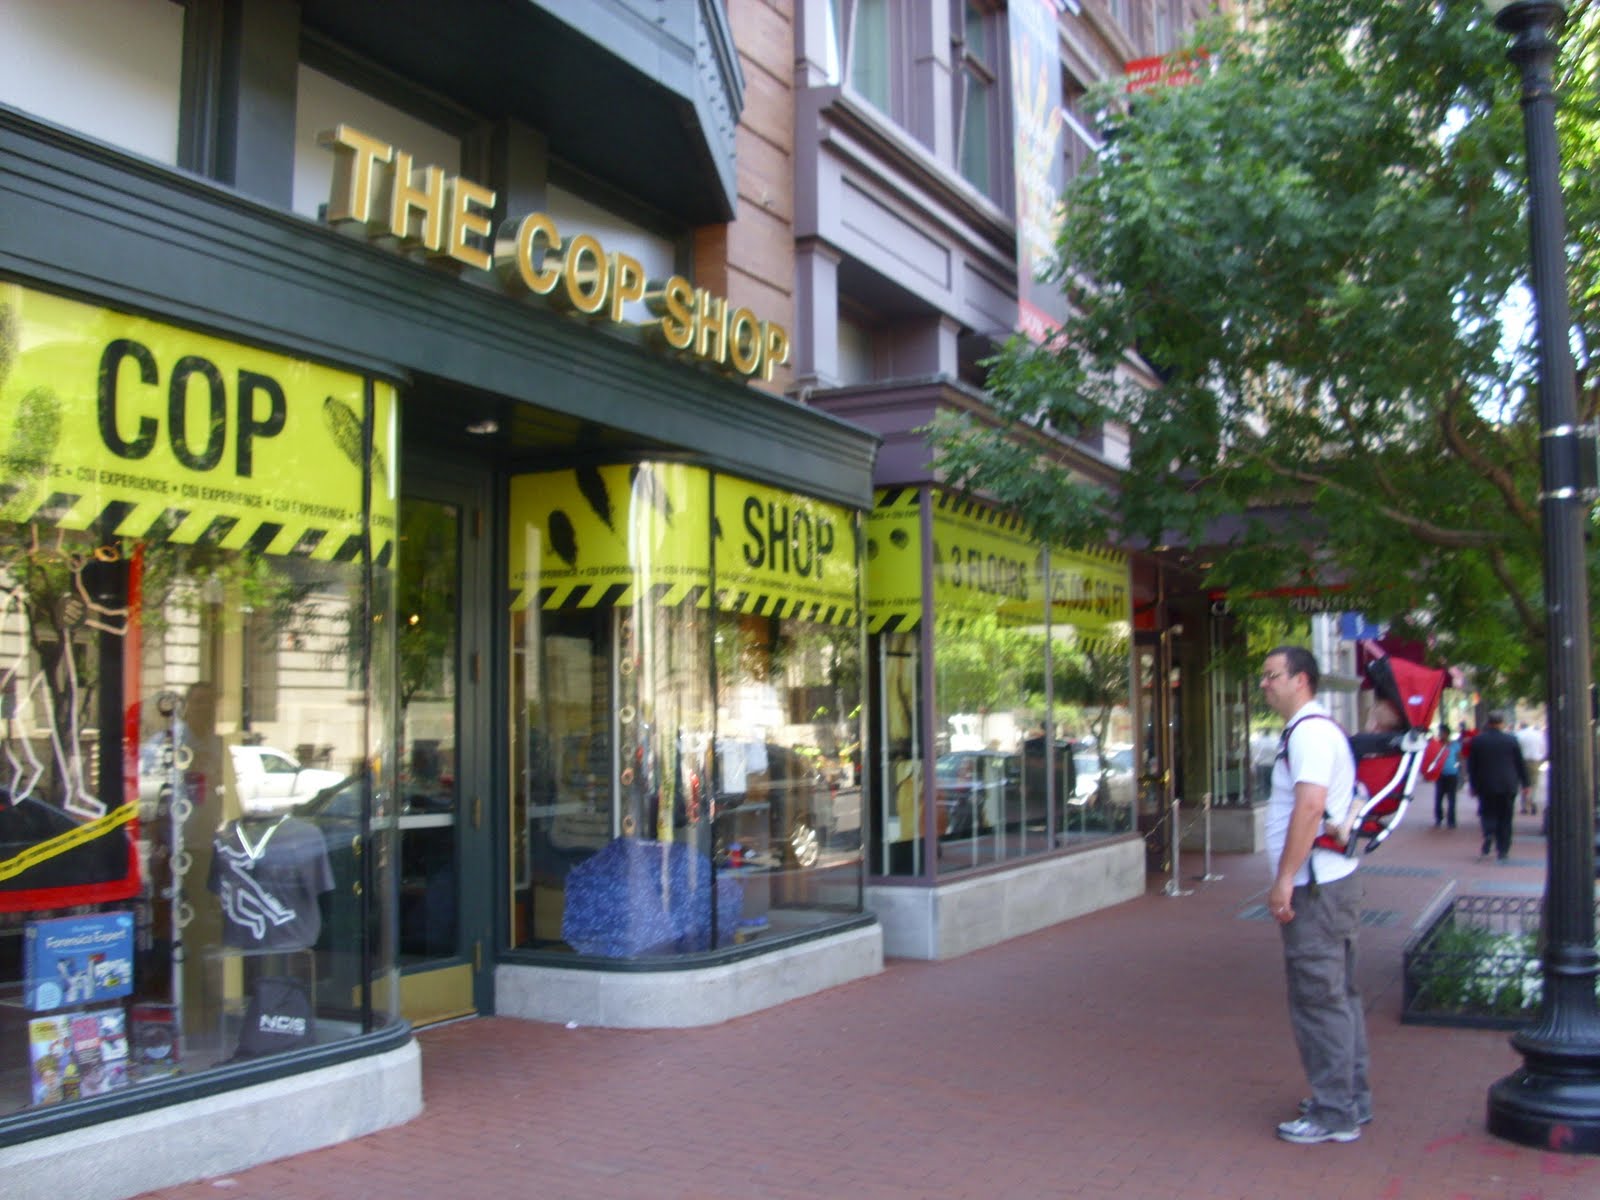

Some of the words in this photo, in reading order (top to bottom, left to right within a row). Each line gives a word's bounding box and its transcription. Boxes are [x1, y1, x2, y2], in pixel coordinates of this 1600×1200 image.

[336, 124, 496, 271] THE
[517, 212, 647, 323] COP
[662, 275, 791, 383] SHOP
[96, 338, 288, 479] COP
[100, 470, 168, 494] EXPERIENCE
[742, 495, 835, 581] SHOP
[259, 1014, 306, 1032] NCIS
